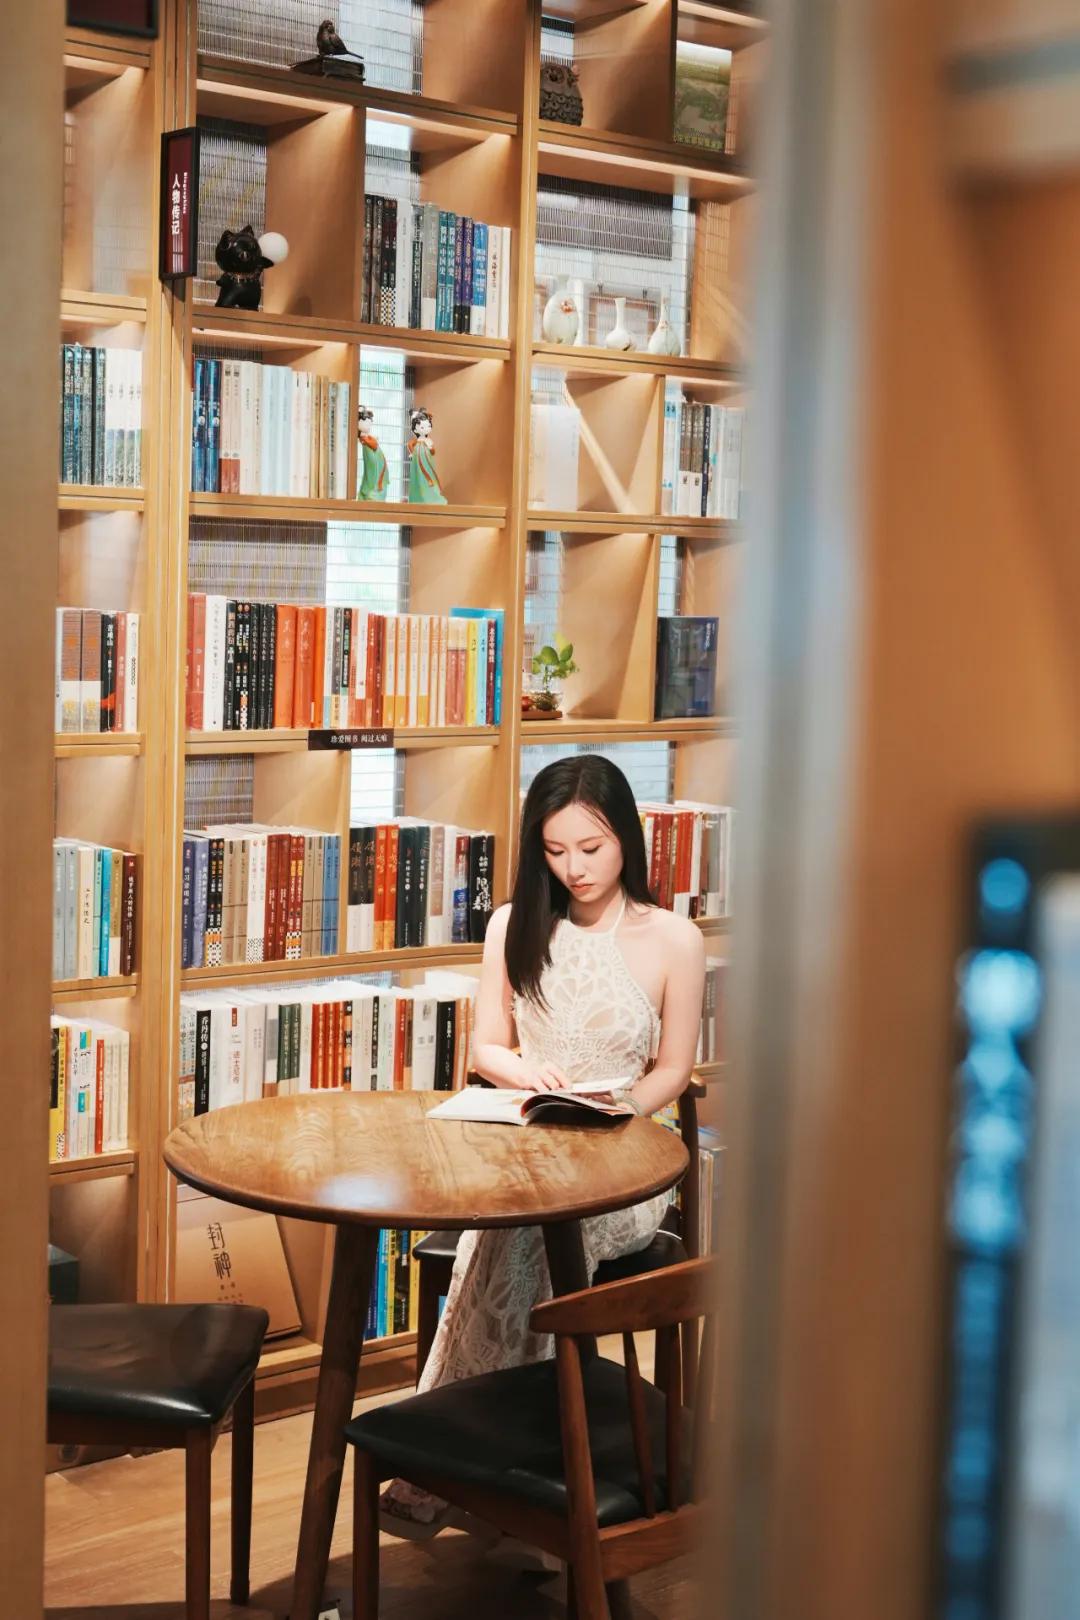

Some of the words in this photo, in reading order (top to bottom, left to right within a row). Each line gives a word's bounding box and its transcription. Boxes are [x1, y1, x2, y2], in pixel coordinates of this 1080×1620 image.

[171, 173, 181, 235] 人物传记
[207, 1222, 232, 1280] 封神
